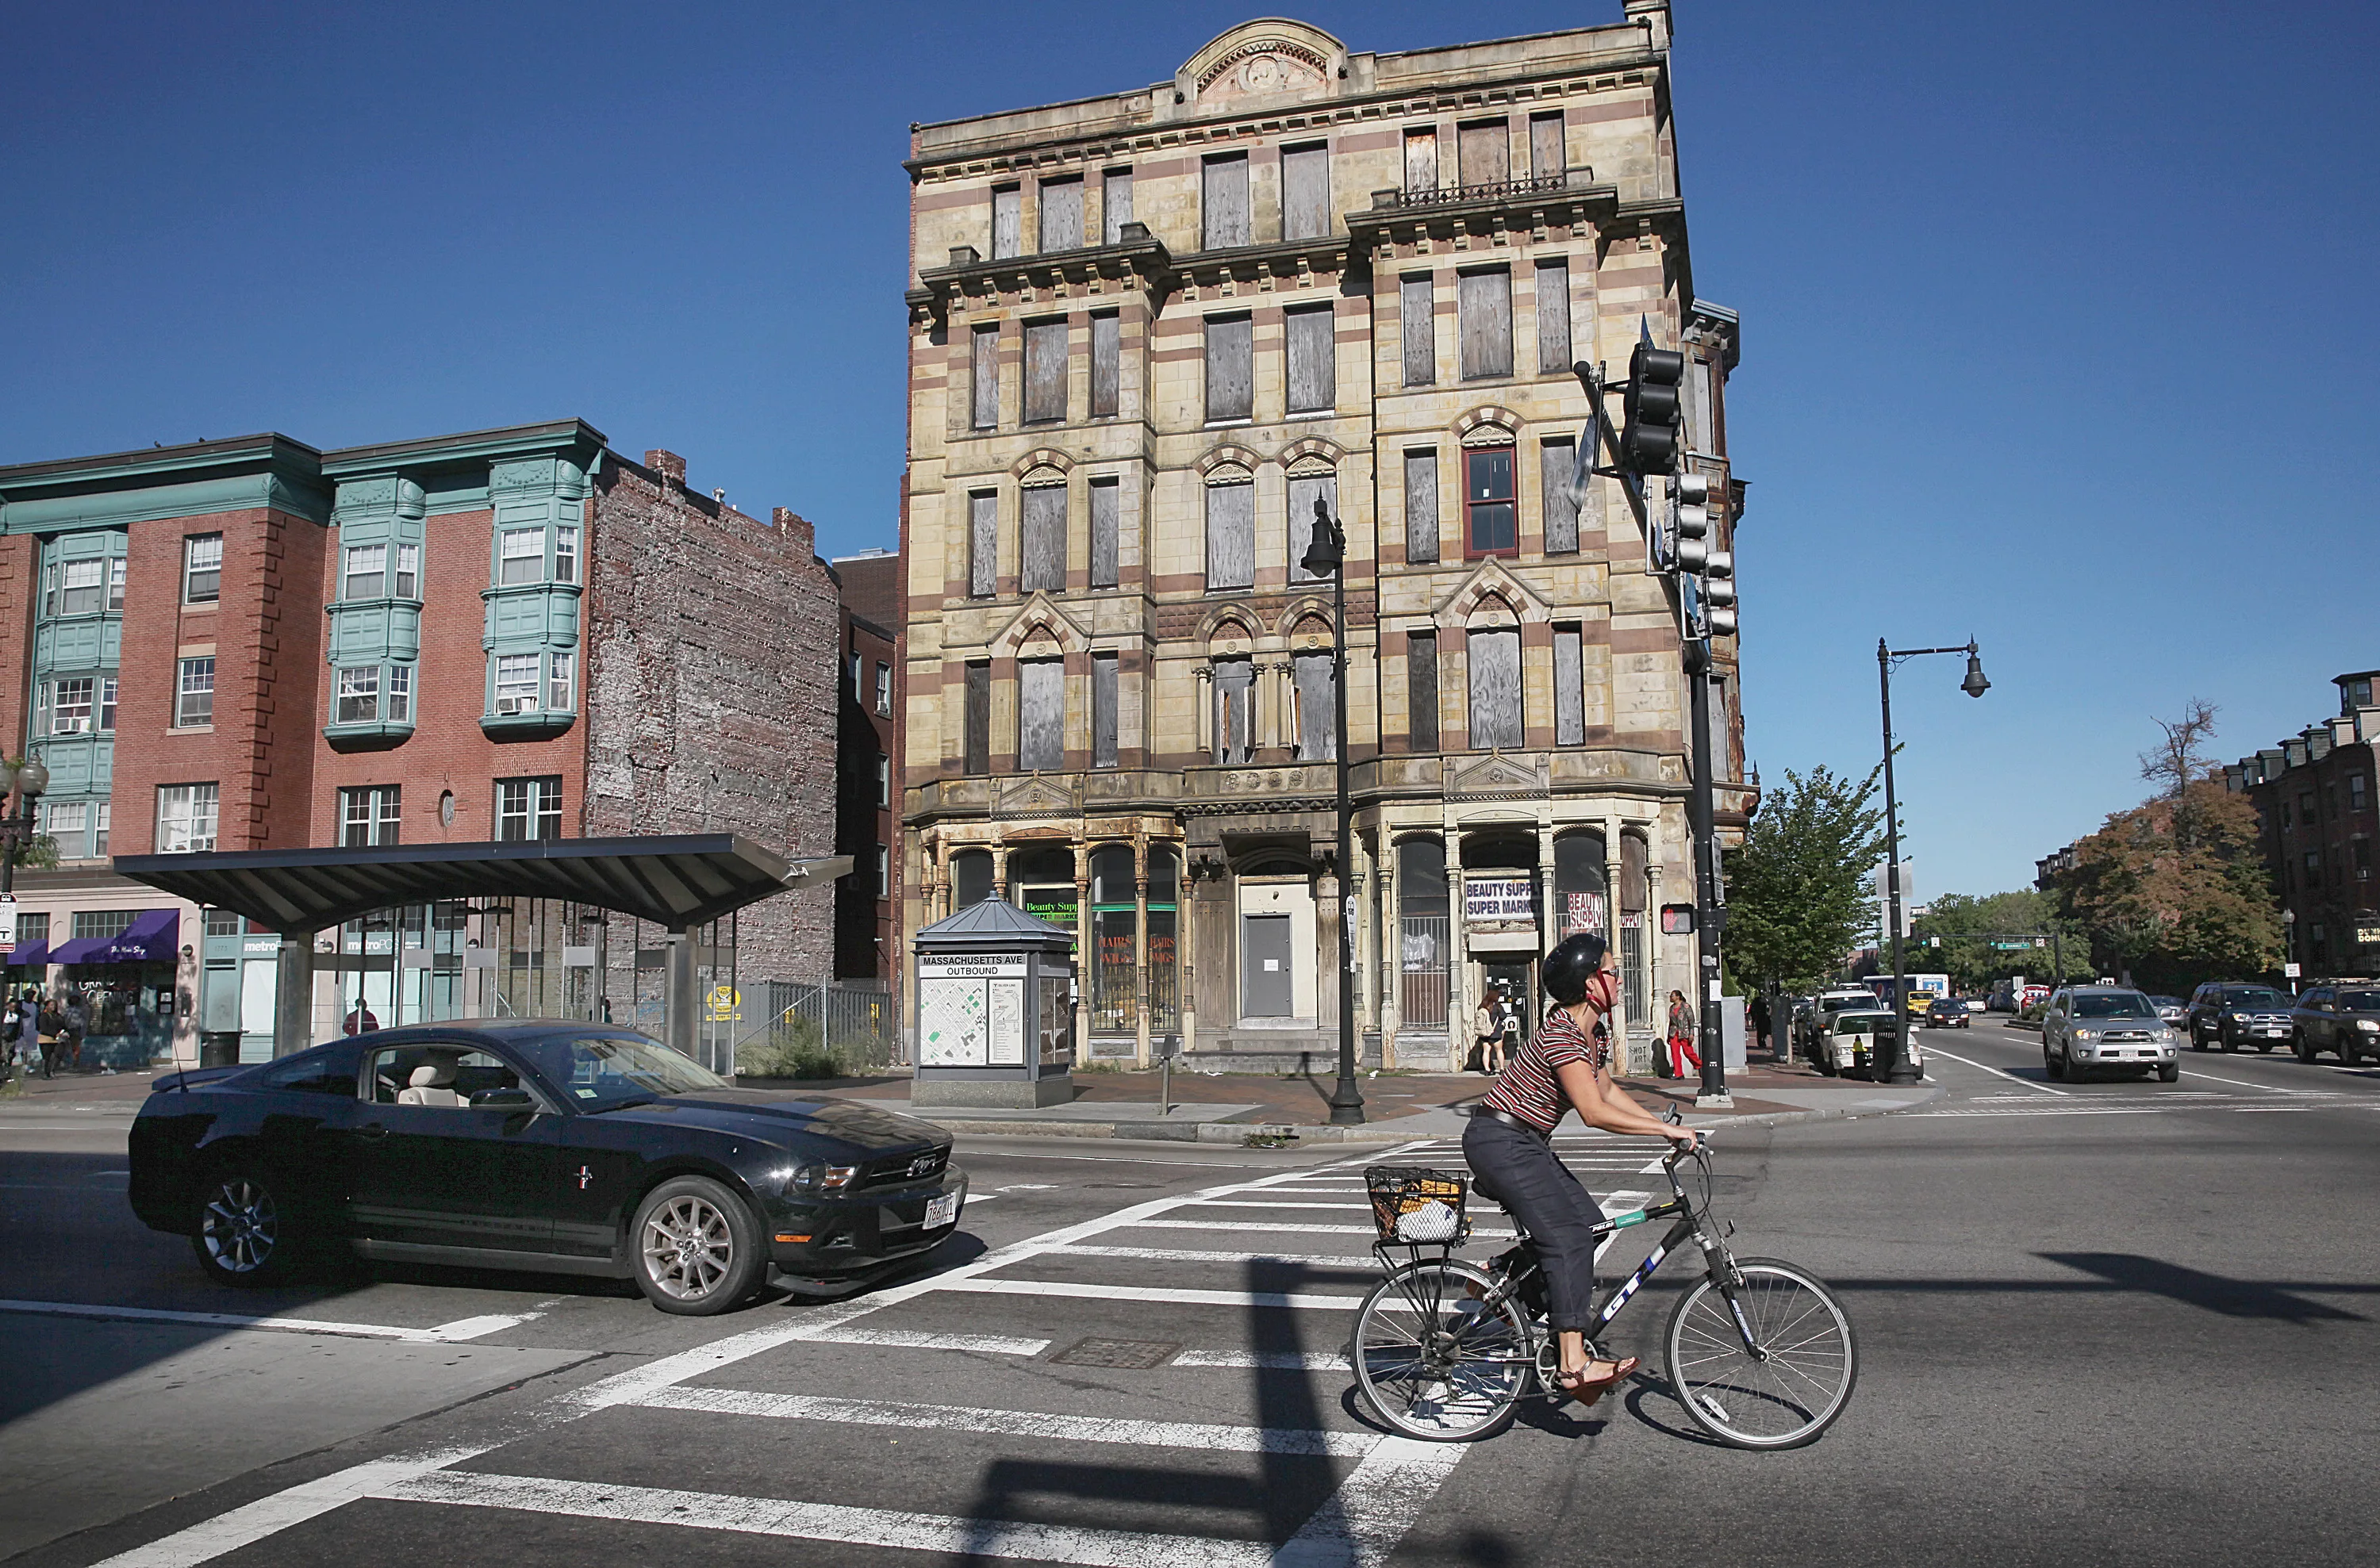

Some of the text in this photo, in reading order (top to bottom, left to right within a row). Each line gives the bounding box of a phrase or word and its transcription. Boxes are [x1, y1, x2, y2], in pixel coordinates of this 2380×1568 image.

[1467, 884, 1504, 897] BEAUTY
[1027, 903, 1055, 913] Beauty
[1468, 901, 1499, 914] SUPER
[1568, 894, 1602, 911] BEAUTY
[1571, 911, 1602, 928] SUPPLY
[1098, 937, 1132, 948] HAIRS
[1150, 937, 1175, 948] HAIRS
[923, 955, 1023, 965] MASSACHUSETTS AVE
[1100, 953, 1132, 964] WIGS
[1150, 953, 1174, 962] WIGS
[946, 967, 998, 976] OUTBOUND
